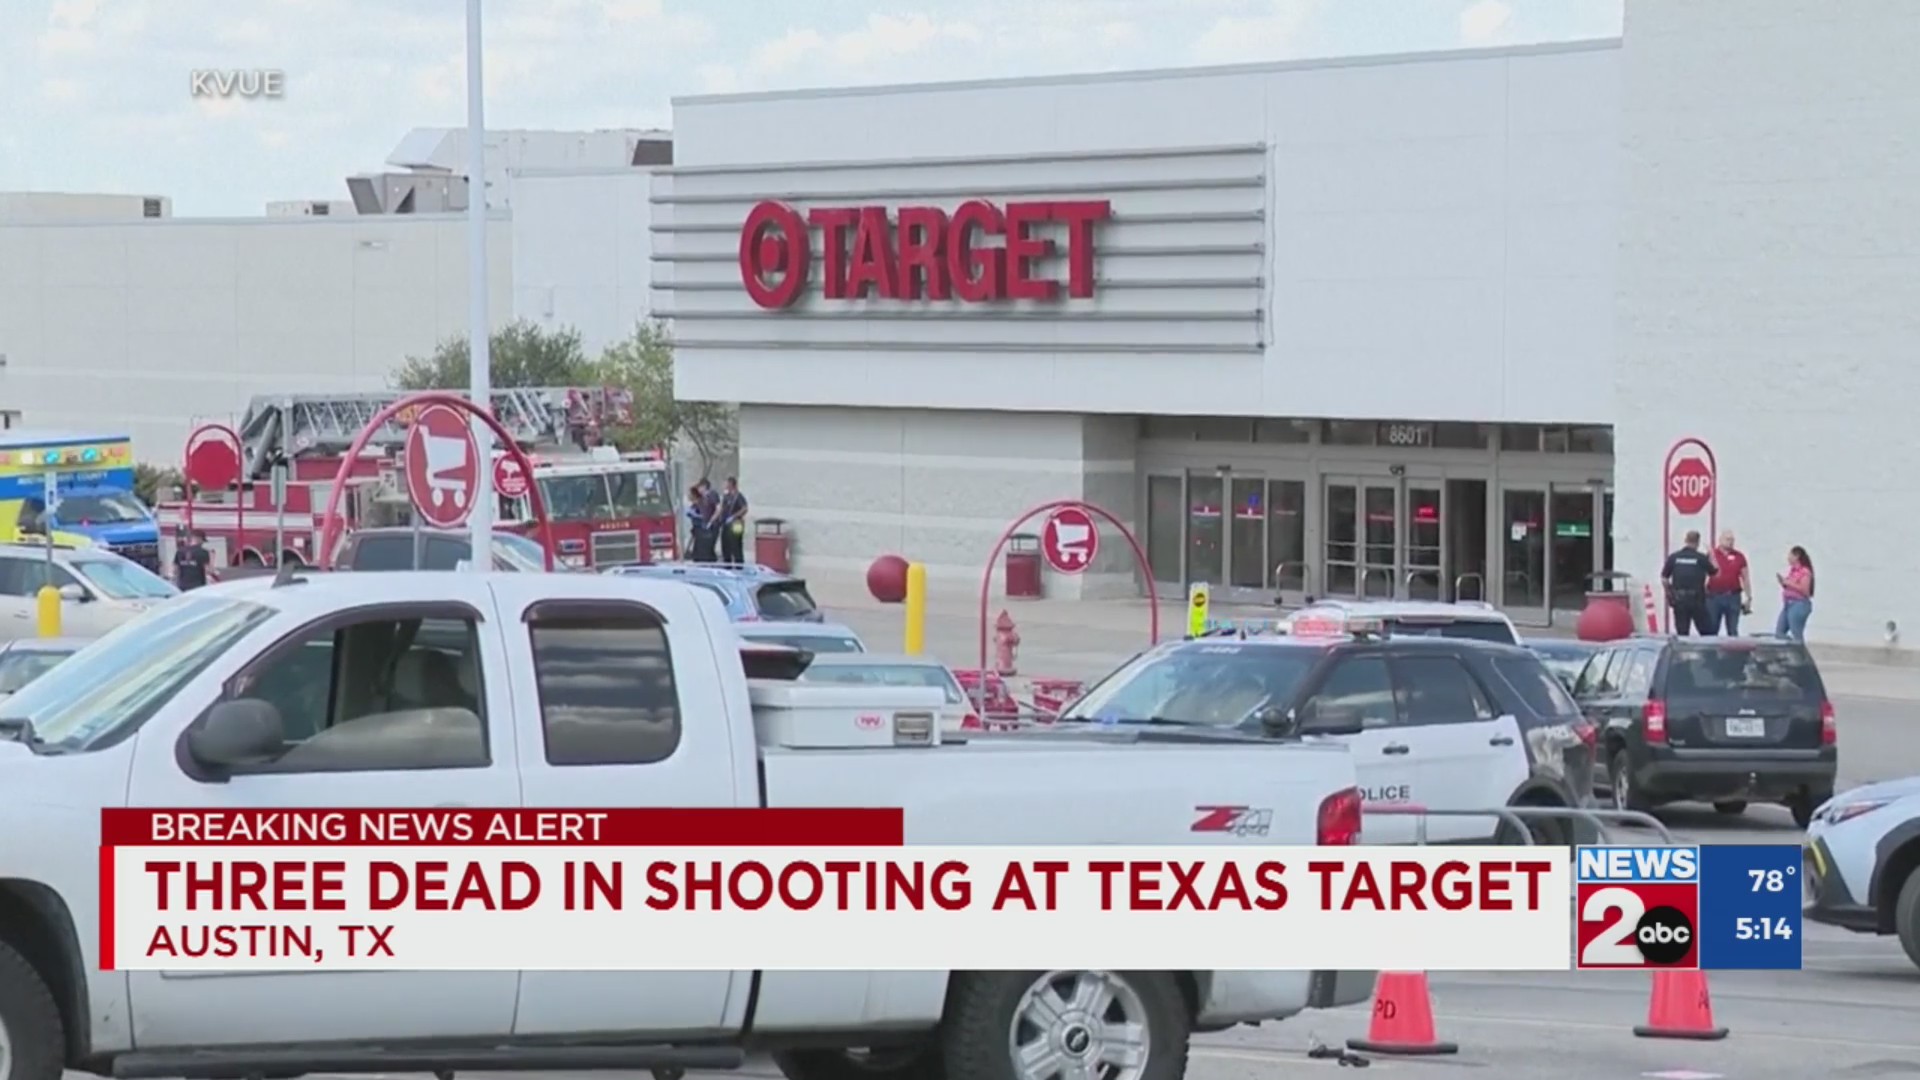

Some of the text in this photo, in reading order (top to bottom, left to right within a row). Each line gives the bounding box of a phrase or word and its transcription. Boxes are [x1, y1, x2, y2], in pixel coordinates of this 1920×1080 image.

[808, 199, 1111, 303] TARGET
[1389, 424, 1422, 444] 8601
[1671, 474, 1711, 498] STOP
